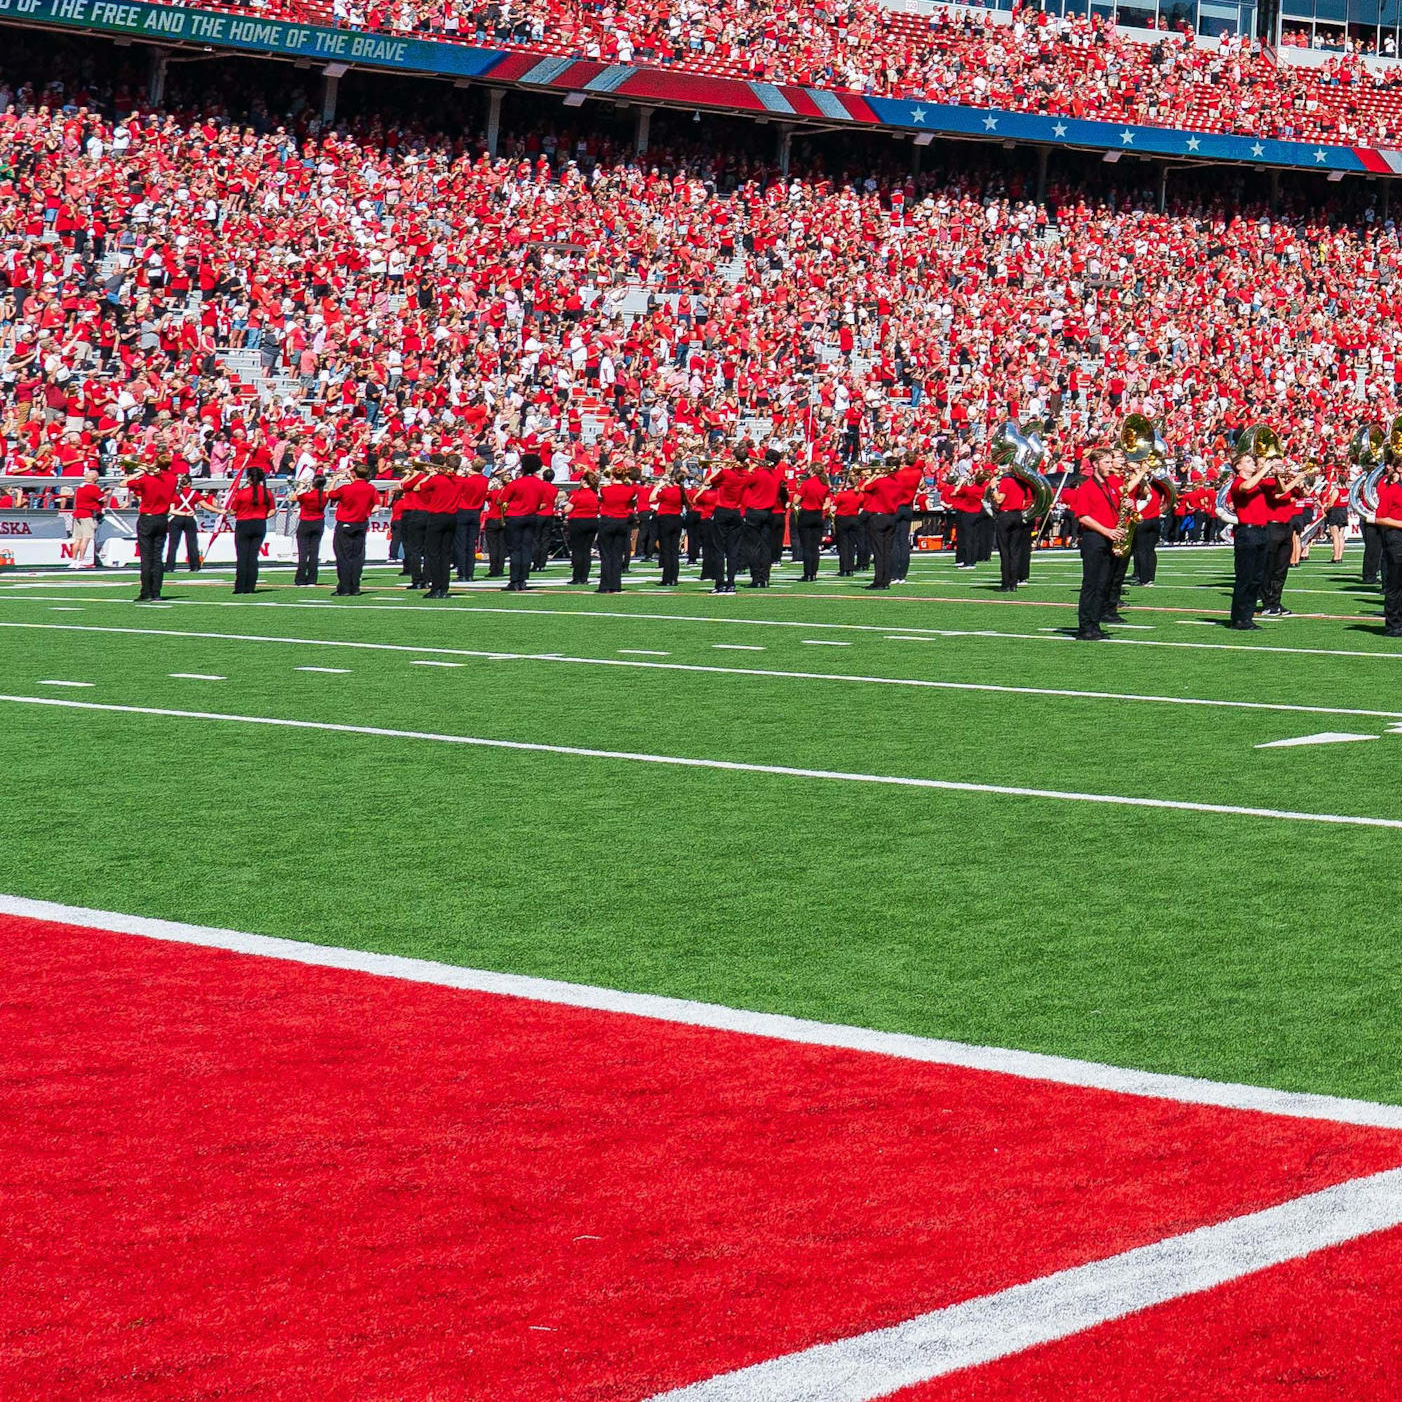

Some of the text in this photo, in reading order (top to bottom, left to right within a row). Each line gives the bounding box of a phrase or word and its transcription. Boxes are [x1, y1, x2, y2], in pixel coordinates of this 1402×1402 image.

[91, 1, 141, 27] FREE
[143, 9, 185, 33] AND
[191, 15, 227, 39] THE
[229, 20, 282, 46] HOME
[285, 28, 311, 48] OF
[316, 32, 349, 54] THE
[351, 37, 408, 62] BRAVE
